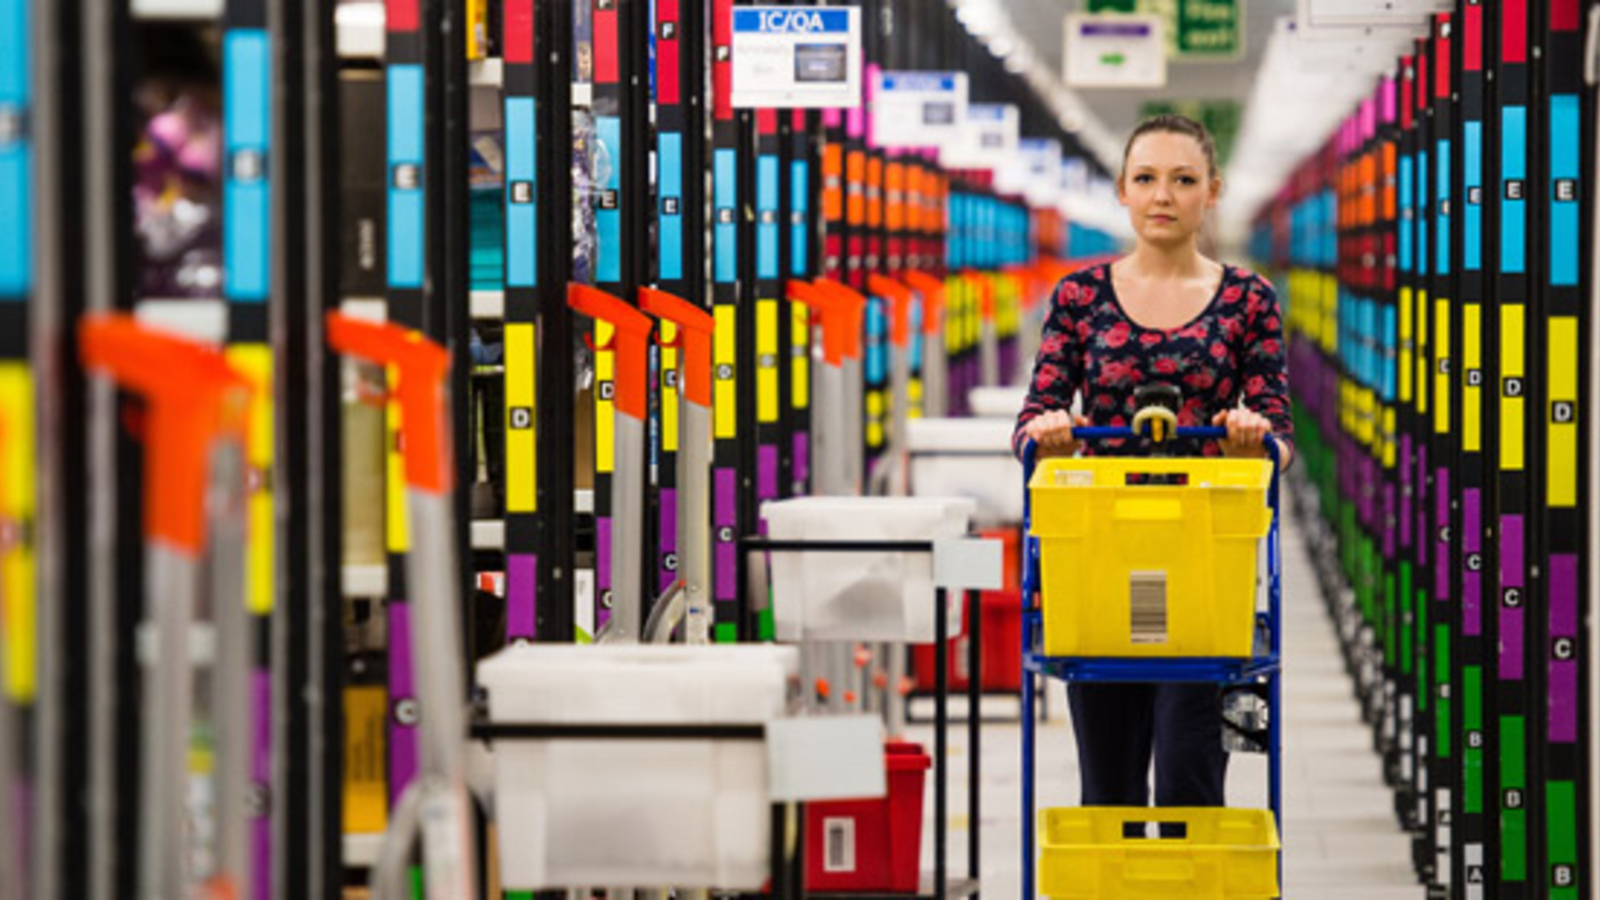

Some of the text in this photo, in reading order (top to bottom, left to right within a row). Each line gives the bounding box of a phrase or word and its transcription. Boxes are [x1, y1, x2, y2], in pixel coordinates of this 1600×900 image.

[662, 22, 675, 38] F
[1507, 181, 1521, 199] E
[1557, 180, 1573, 200] E
[601, 191, 615, 208] E
[665, 199, 676, 213] E
[1469, 370, 1482, 385] D
[602, 383, 613, 398] D
[1506, 379, 1521, 396] D
[512, 409, 529, 427] D
[1554, 402, 1571, 421] D
[720, 528, 733, 542] C
[665, 554, 678, 569] C
[1468, 554, 1481, 570] C
[1504, 588, 1519, 606] C
[1554, 638, 1571, 659] C
[1469, 731, 1482, 747] B
[1506, 789, 1521, 807] B
[1470, 867, 1482, 883] A
[1555, 865, 1571, 885] B
